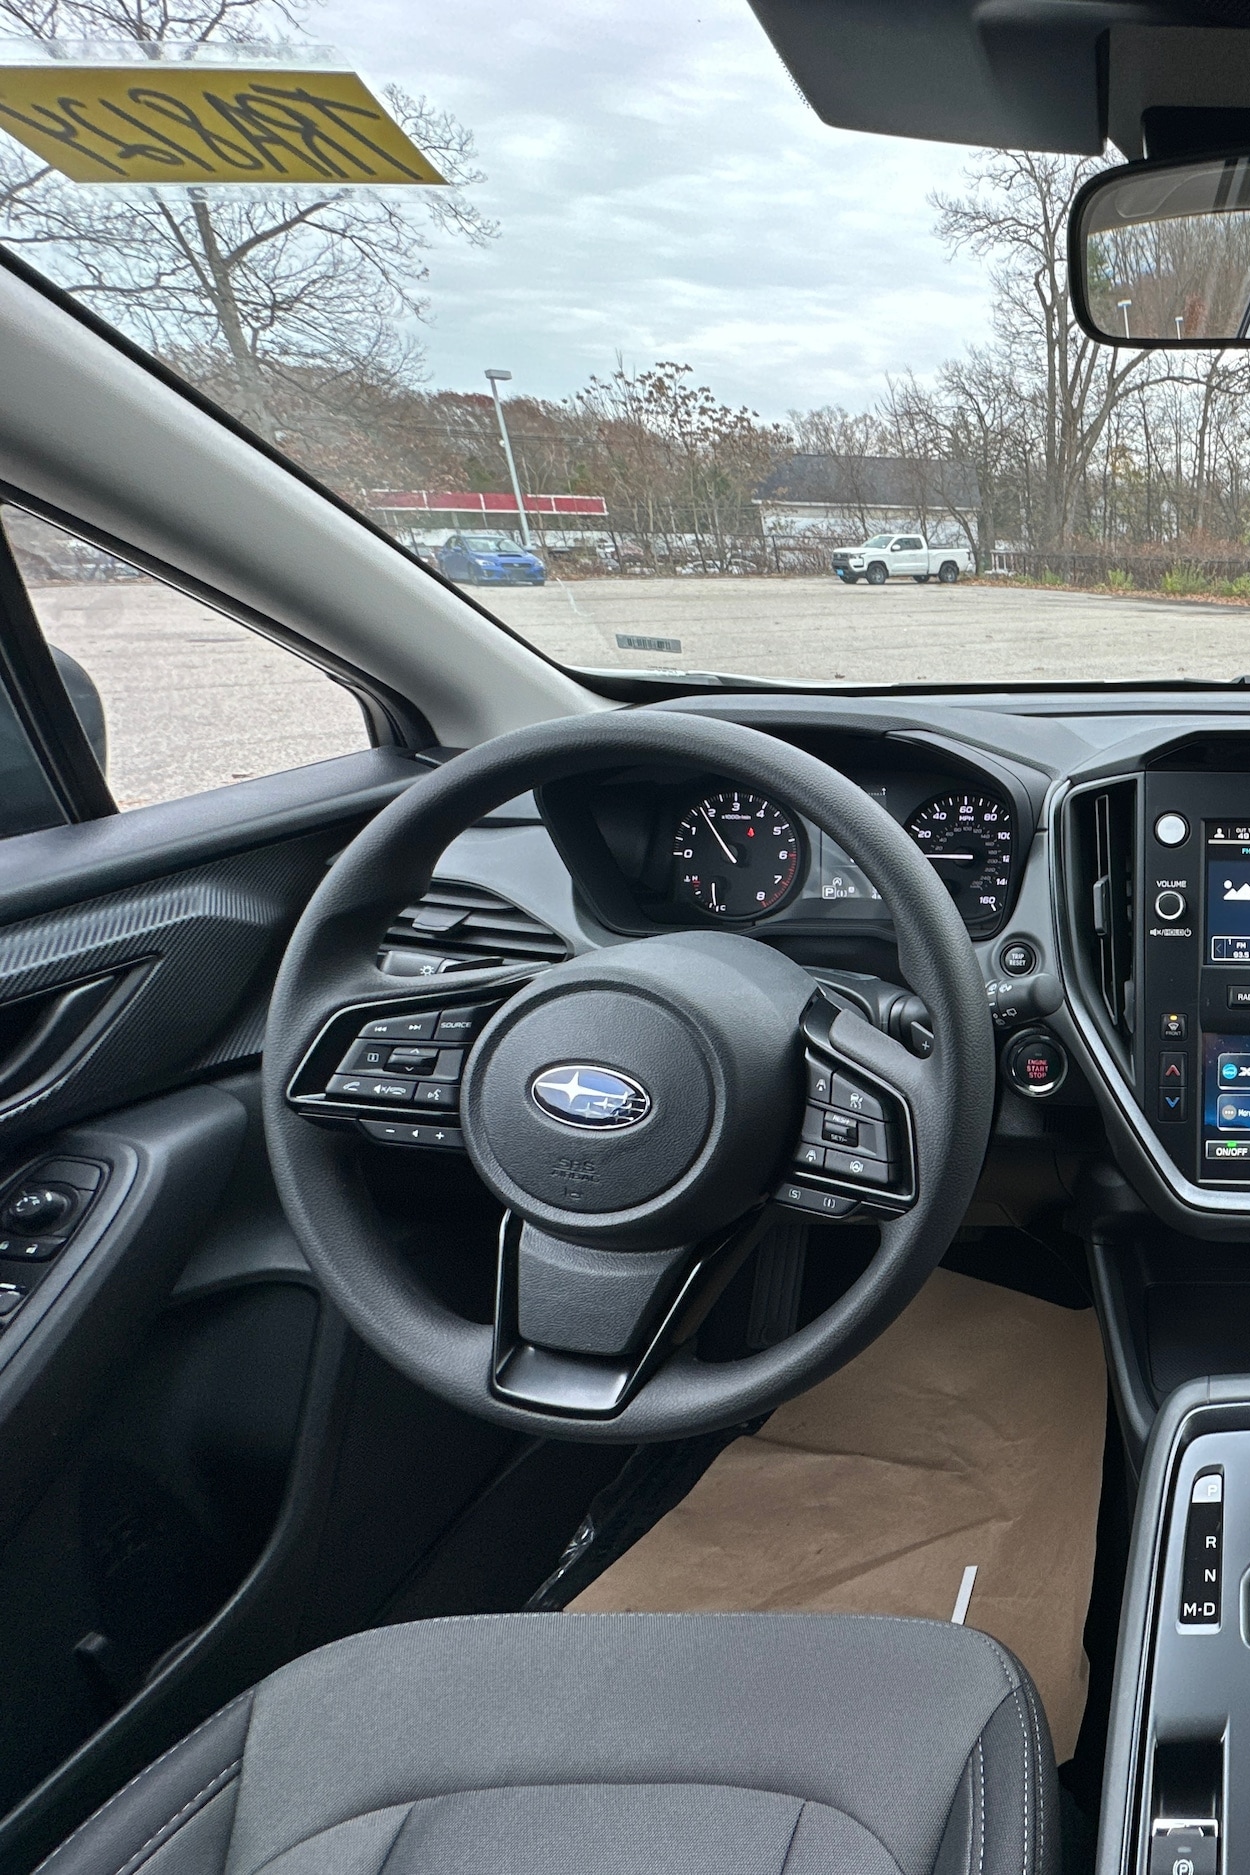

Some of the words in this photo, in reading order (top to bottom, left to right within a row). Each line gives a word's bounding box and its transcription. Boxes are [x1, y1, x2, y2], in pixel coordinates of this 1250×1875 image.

[731, 802, 740, 811] 3
[959, 806, 973, 814] 60
[708, 808, 716, 818] 2
[756, 809, 765, 818] 4
[932, 812, 947, 820] 40
[984, 813, 998, 821] 80
[691, 827, 697, 835] 1
[772, 826, 782, 836] 5
[918, 830, 931, 838] 20
[683, 849, 693, 859] 0
[779, 850, 788, 860] 6
[774, 875, 782, 884] 7
[1156, 880, 1187, 888] VOLUME
[756, 891, 765, 901] 8
[825, 888, 834, 897] P
[979, 896, 996, 904] 160
[1216, 1147, 1248, 1156] ON/OFF
[1207, 1484, 1218, 1496] P
[1205, 1536, 1217, 1549] R
[1204, 1569, 1216, 1582] N
